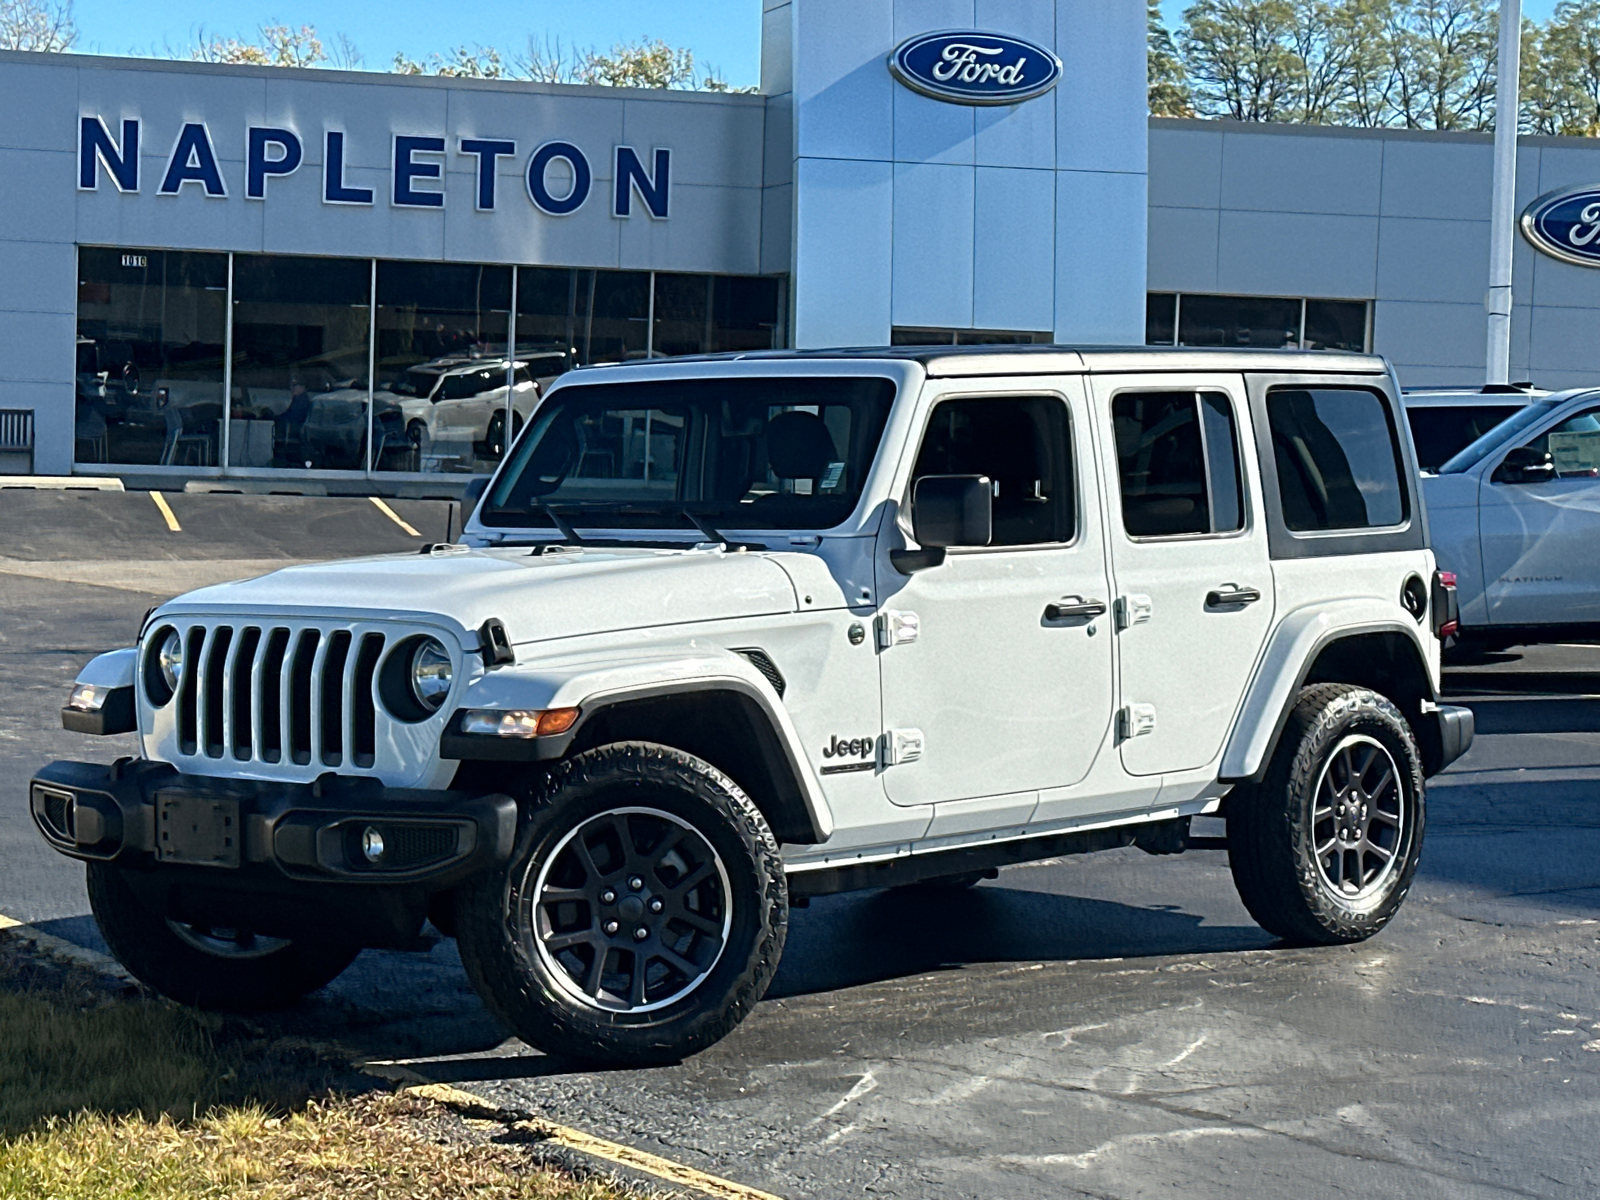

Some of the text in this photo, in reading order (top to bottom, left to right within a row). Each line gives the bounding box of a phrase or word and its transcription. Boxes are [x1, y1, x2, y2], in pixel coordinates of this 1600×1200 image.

[932, 43, 1026, 85] Ford
[78, 114, 671, 219] NAPLETON
[823, 734, 874, 759] Jeep
